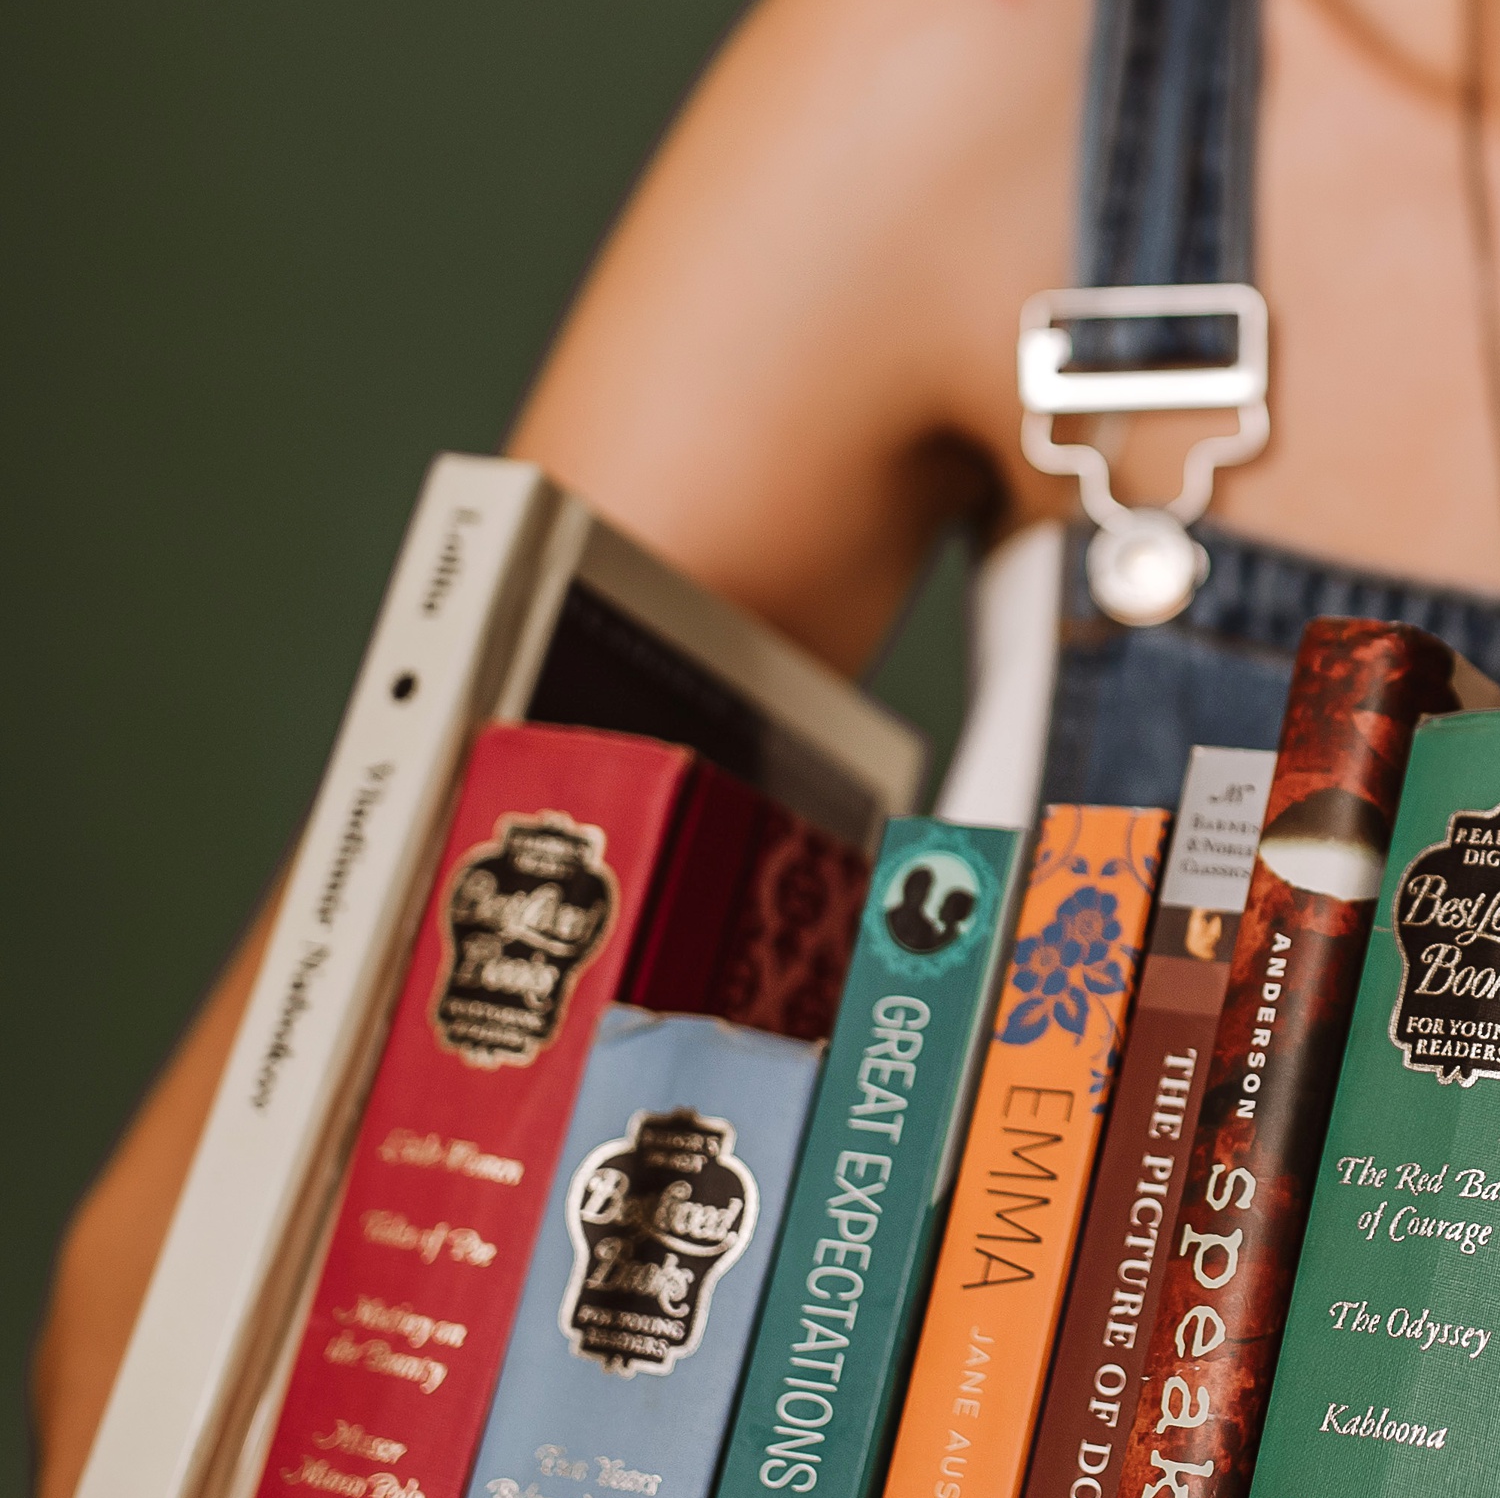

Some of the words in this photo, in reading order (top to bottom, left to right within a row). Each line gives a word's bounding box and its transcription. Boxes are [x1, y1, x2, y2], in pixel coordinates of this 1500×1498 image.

[1402, 874, 1486, 929] Best
[1237, 932, 1292, 1120] ANDERSON
[1406, 1016, 1445, 1035] FOR
[848, 994, 932, 1145] GREAT
[1147, 1047, 1198, 1142] THE
[962, 1084, 1076, 1291] EMMA
[1336, 1155, 1388, 1189] The
[1394, 1161, 1450, 1196] Red
[1102, 1153, 1176, 1351] PICTURE
[1356, 1201, 1388, 1241] of
[1389, 1205, 1494, 1256] Courage
[758, 1149, 894, 1494] EXPECTATIONS
[1328, 1301, 1381, 1335] The
[1385, 1307, 1492, 1359] Odyssey
[951, 1325, 997, 1421] JANE
[1088, 1362, 1128, 1429] OF
[1319, 1402, 1448, 1450] Kabloona
